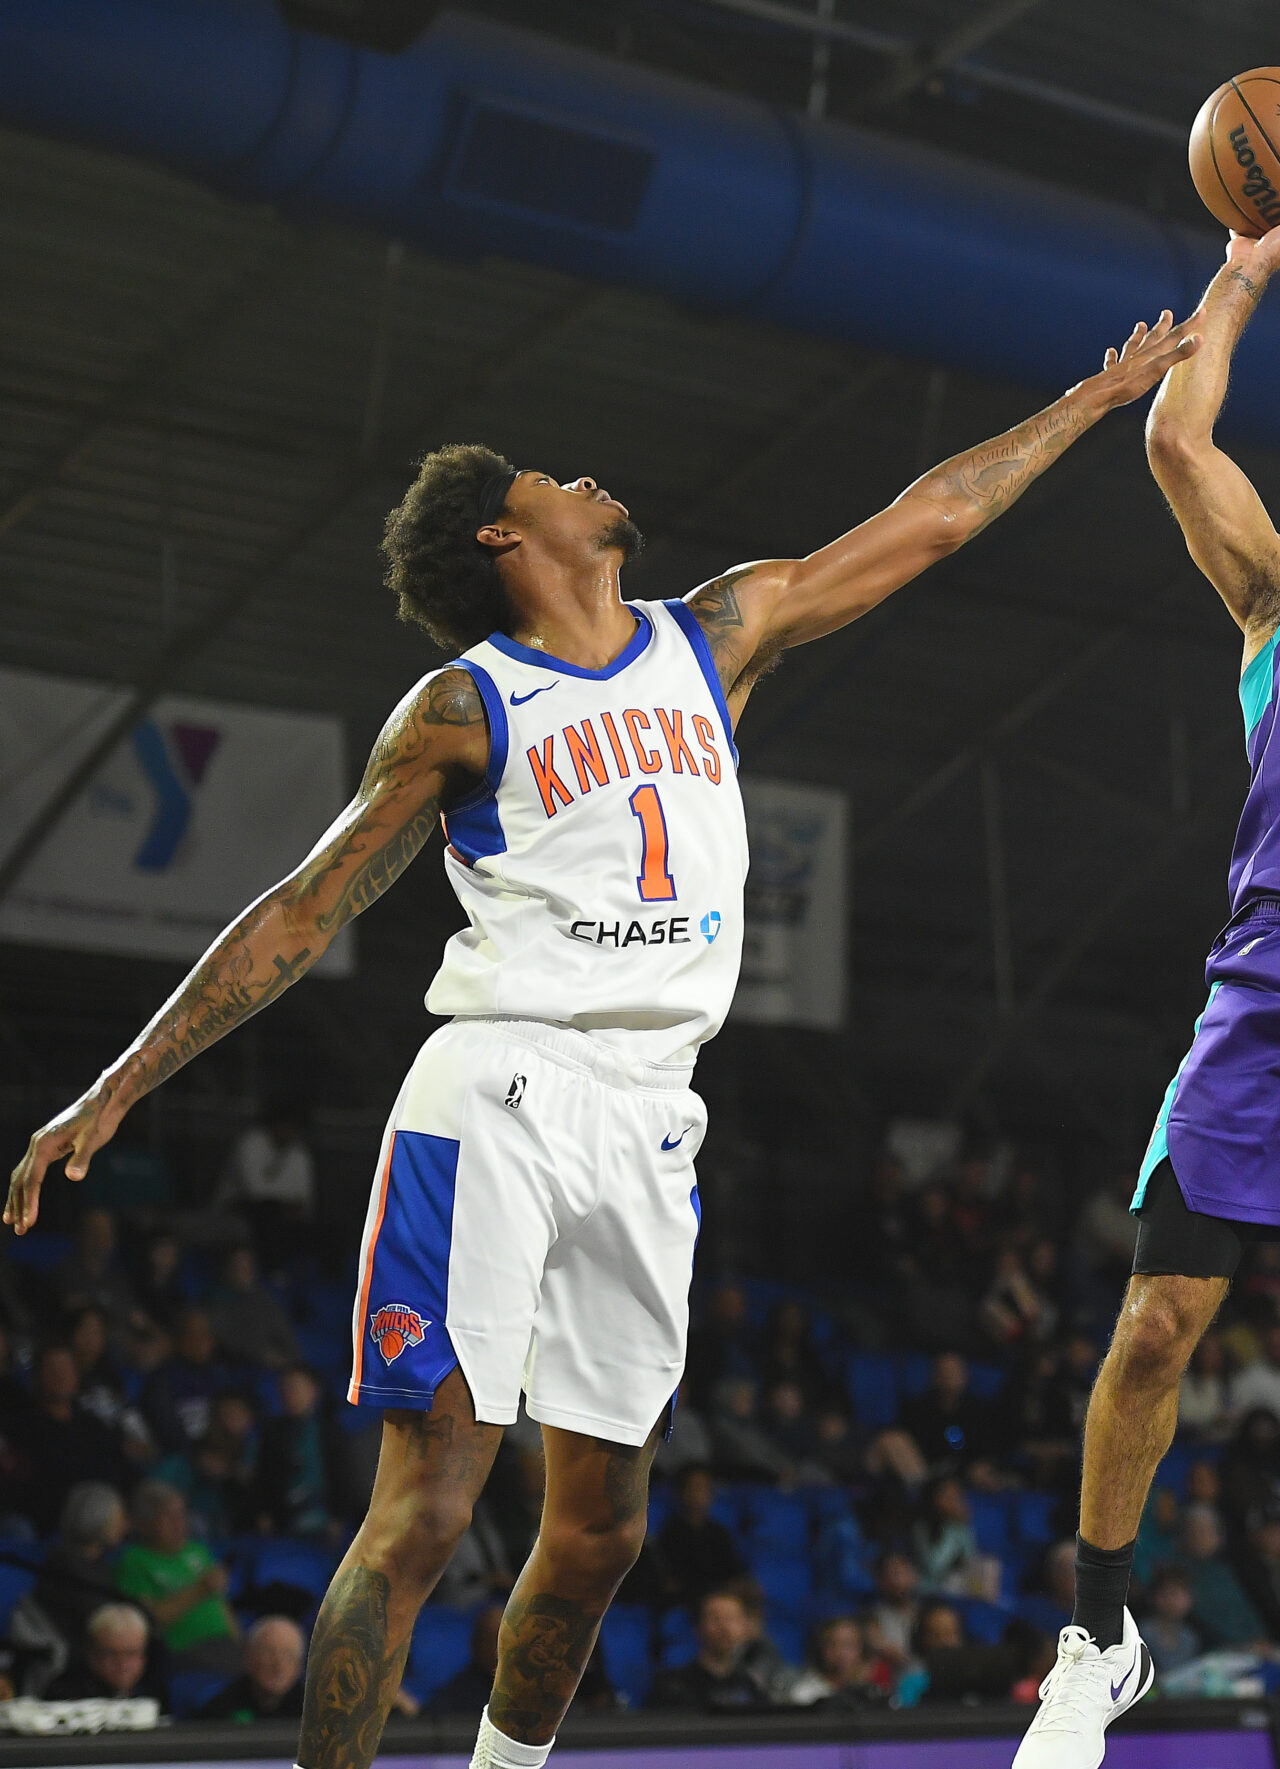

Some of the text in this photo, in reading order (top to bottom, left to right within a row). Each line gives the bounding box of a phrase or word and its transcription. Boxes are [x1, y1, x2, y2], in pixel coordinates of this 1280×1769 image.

[526, 708, 722, 819] KNICKS
[628, 783, 678, 902] 1
[570, 917, 692, 948] CHASE
[372, 1310, 423, 1340] KNICKS
